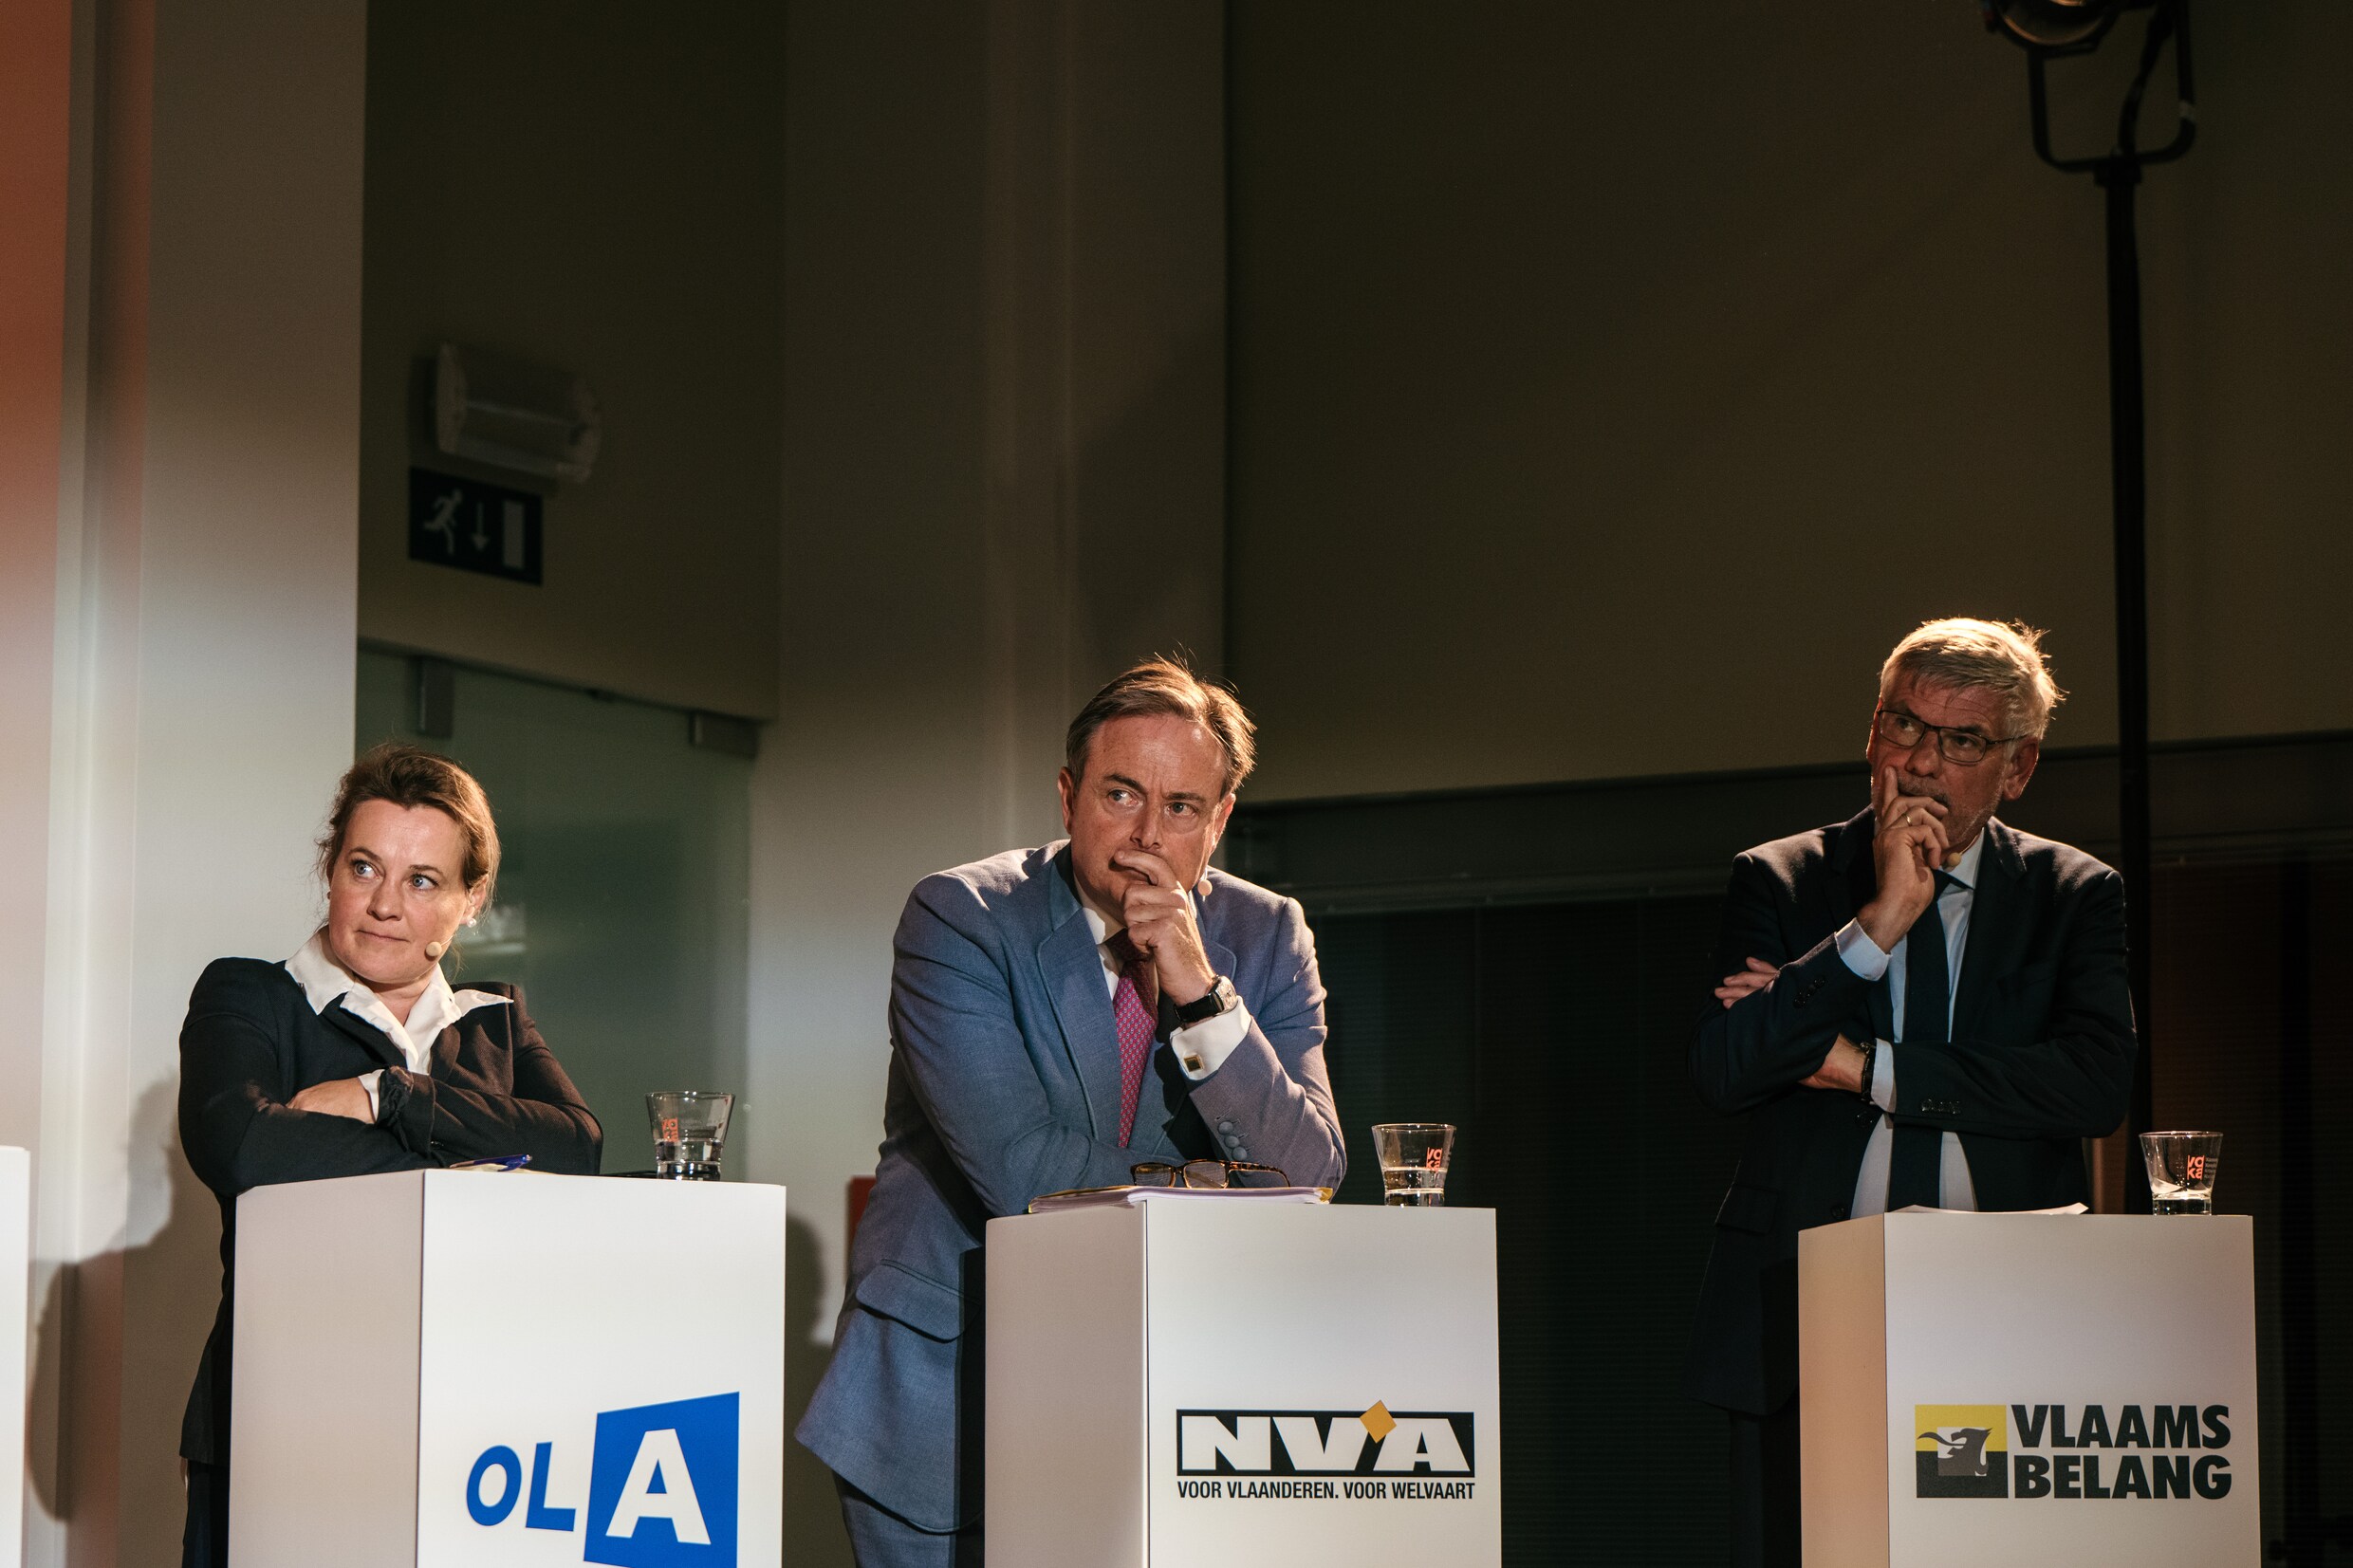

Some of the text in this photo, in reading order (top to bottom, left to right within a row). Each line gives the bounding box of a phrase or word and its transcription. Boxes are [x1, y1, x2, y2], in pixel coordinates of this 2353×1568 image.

[2010, 1404, 2232, 1449] VLAAMS
[1177, 1481, 1475, 1500] VOOR VLAANDEREN. VOOR WELVAART
[2013, 1454, 2233, 1501] BELANG
